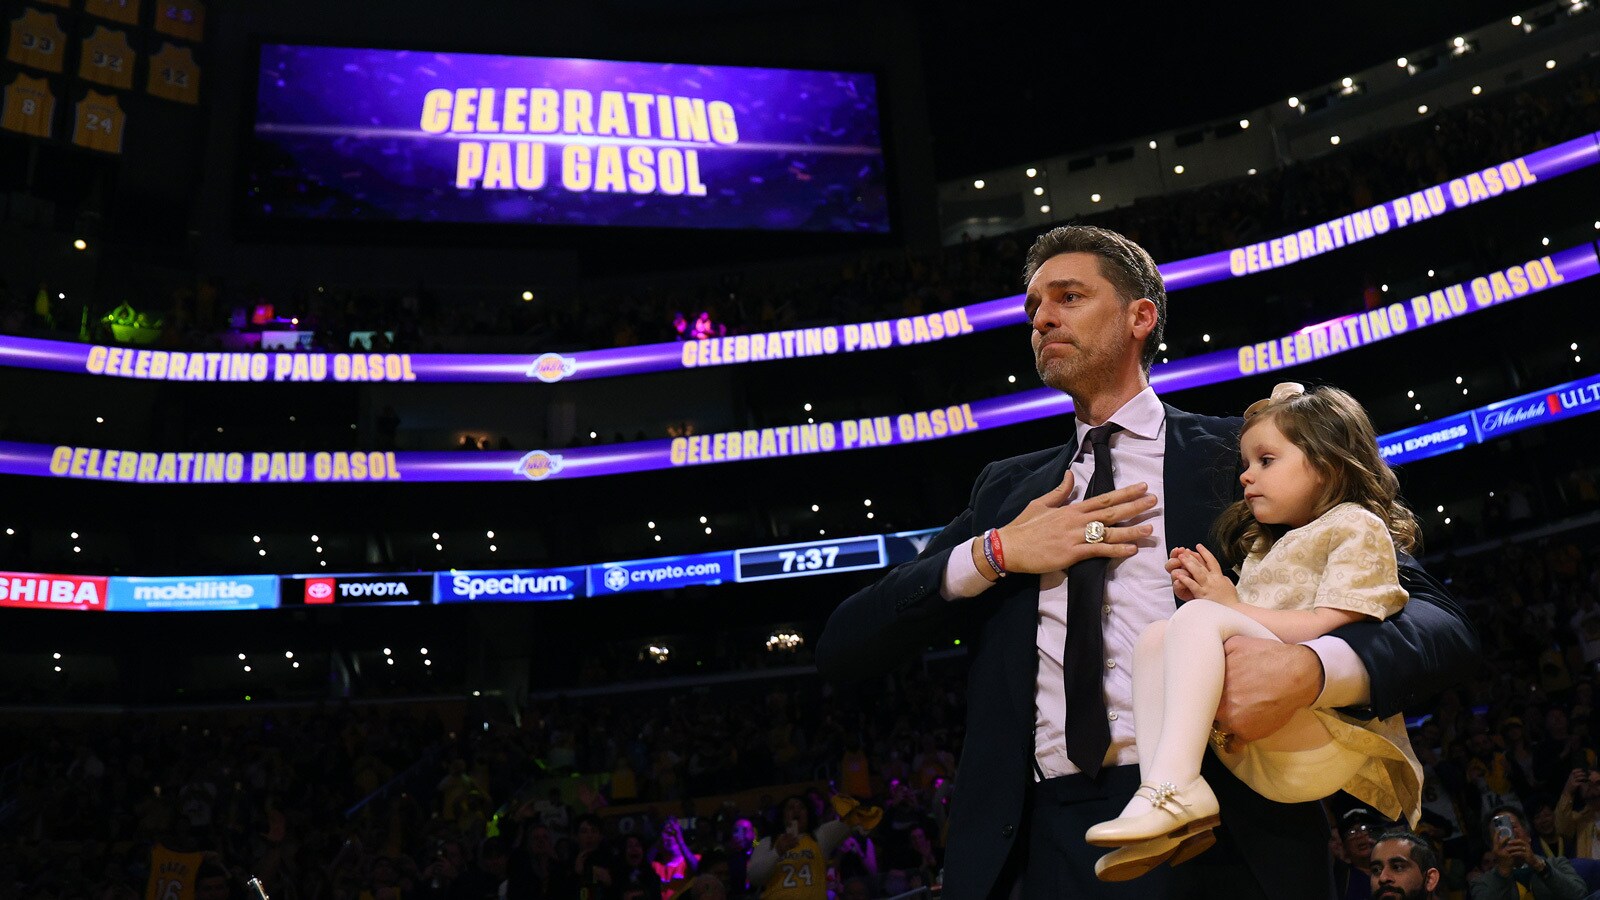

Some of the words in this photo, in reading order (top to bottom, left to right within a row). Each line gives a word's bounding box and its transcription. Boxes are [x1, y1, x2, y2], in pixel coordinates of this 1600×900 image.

[85, 113, 113, 135] 24
[420, 87, 739, 145] CELEBRATING
[455, 142, 546, 189] PAU
[561, 143, 708, 197] GASOL
[1229, 203, 1391, 277] CELEBRATING
[1393, 185, 1447, 228] PAU
[1450, 157, 1537, 208] GASOL
[1237, 302, 1408, 375] CELEBRATING
[1410, 283, 1468, 327] PAU
[1471, 255, 1565, 307] GASOL
[681, 326, 839, 368] CELEBRATING
[843, 319, 893, 351] PAU
[898, 307, 974, 344] GASOL
[86, 346, 268, 382] CELEBRATING
[274, 353, 328, 382] PAU
[333, 354, 417, 381] GASOL
[670, 421, 836, 466] CELEBRATING
[841, 414, 895, 448] PAU
[899, 403, 979, 440] GASOL
[1404, 424, 1468, 452] EXPRESS
[49, 446, 244, 483] CELEBRATING
[250, 452, 306, 482] PAU
[313, 452, 401, 481] GASOL
[630, 562, 721, 583] crypto.com
[778, 545, 840, 573] 7:37
[133, 580, 255, 601] mobilitie
[338, 582, 409, 597] TOYOTA
[452, 573, 567, 600] Spectrum
[782, 863, 813, 889] 24
